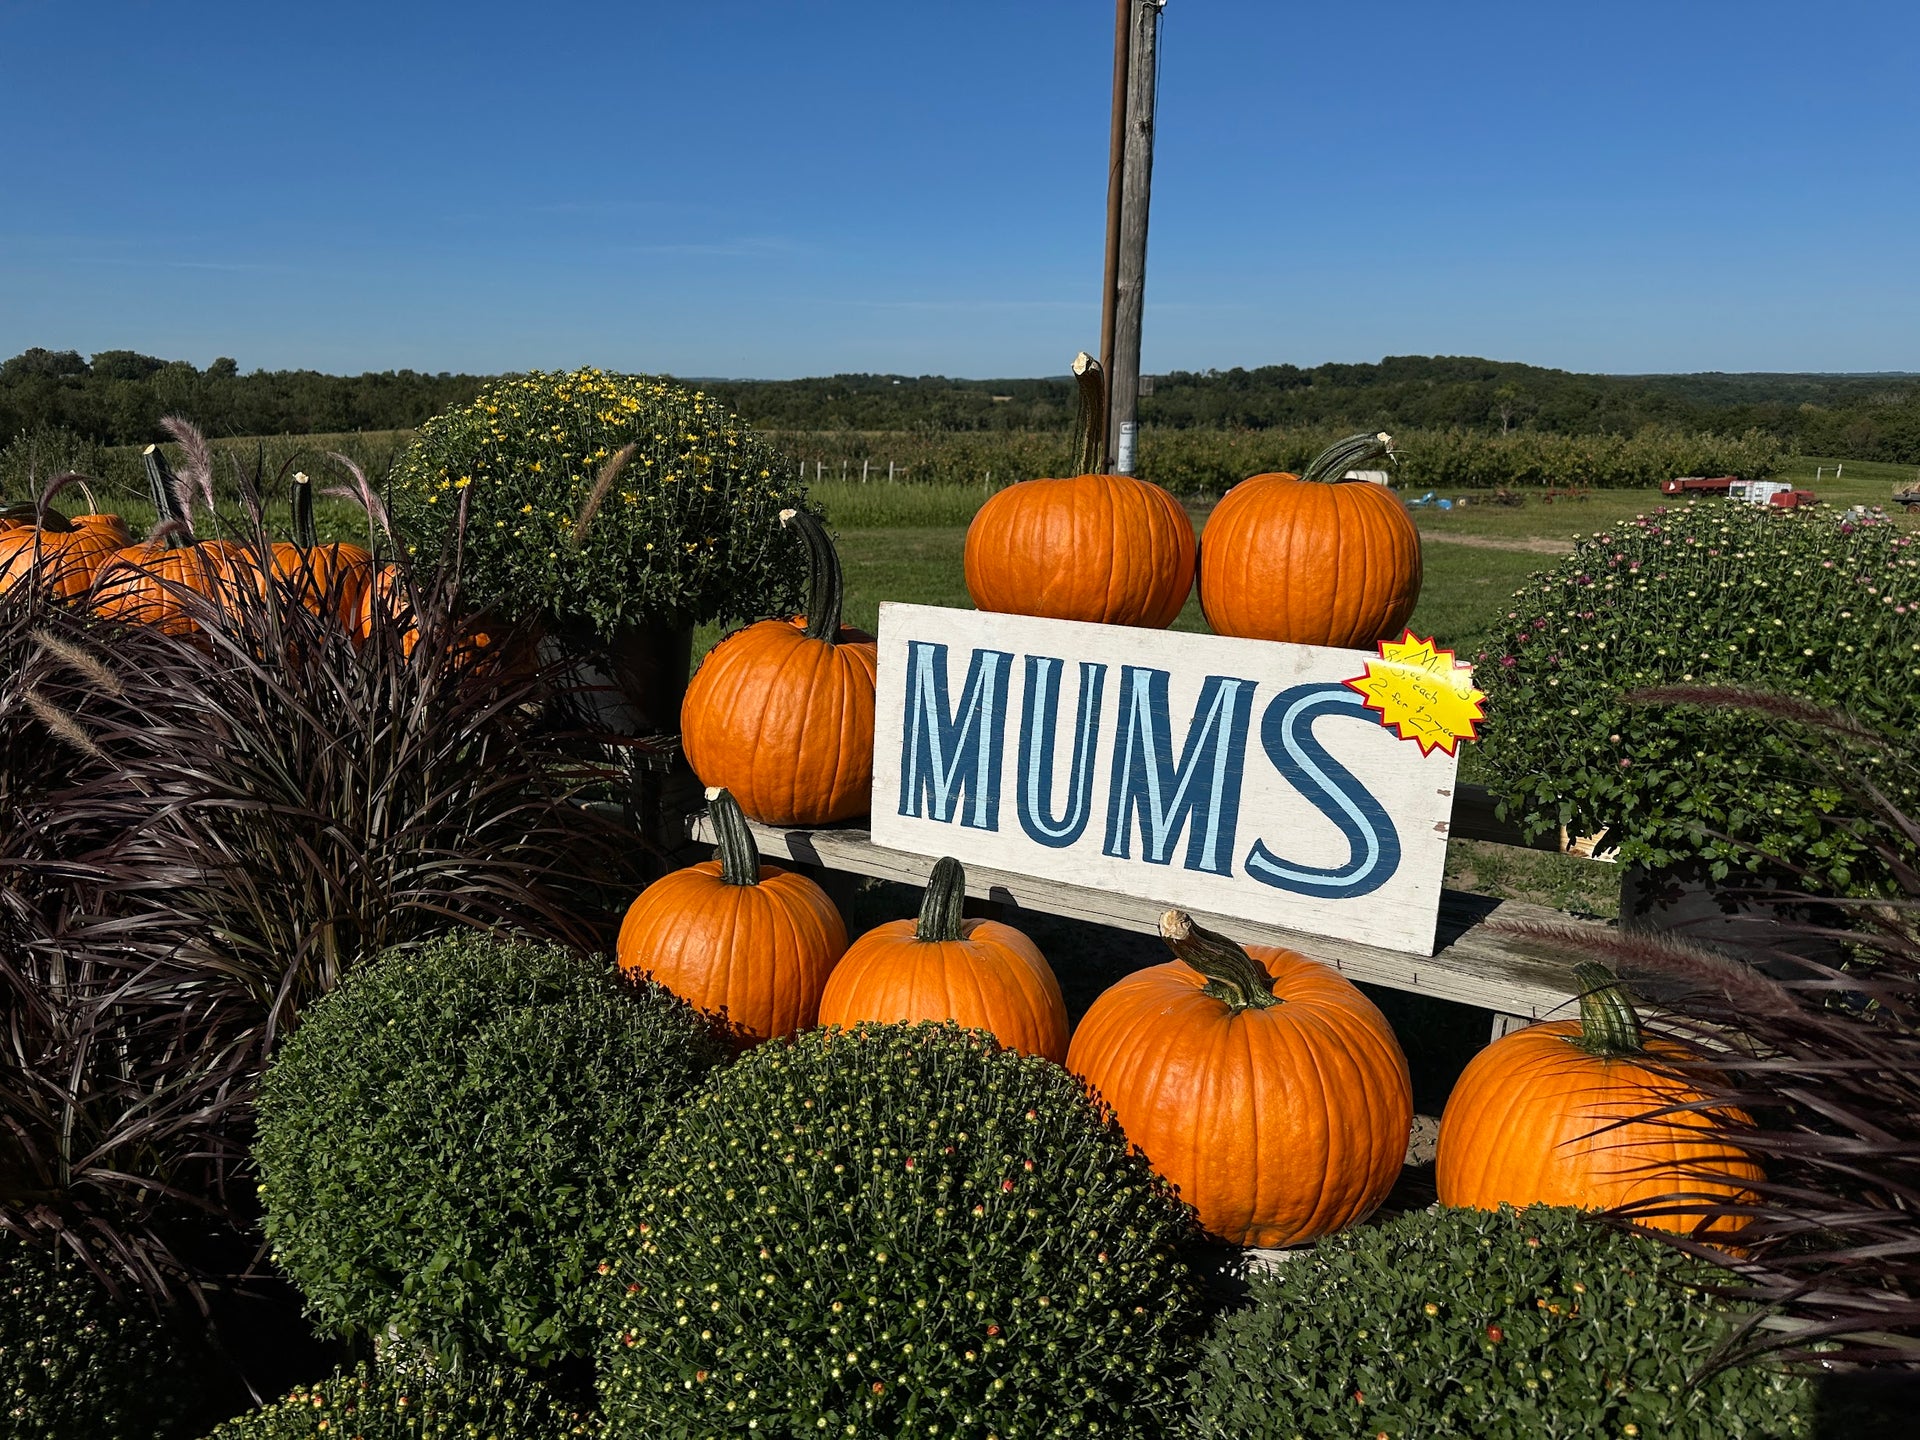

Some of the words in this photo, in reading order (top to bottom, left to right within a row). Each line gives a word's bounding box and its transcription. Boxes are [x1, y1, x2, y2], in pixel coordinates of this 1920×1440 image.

[1368, 677, 1388, 698] 2
[1391, 692, 1409, 709] for
[1403, 648, 1473, 701] Mus
[1412, 684, 1438, 705] each
[898, 640, 1402, 899] MUMS
